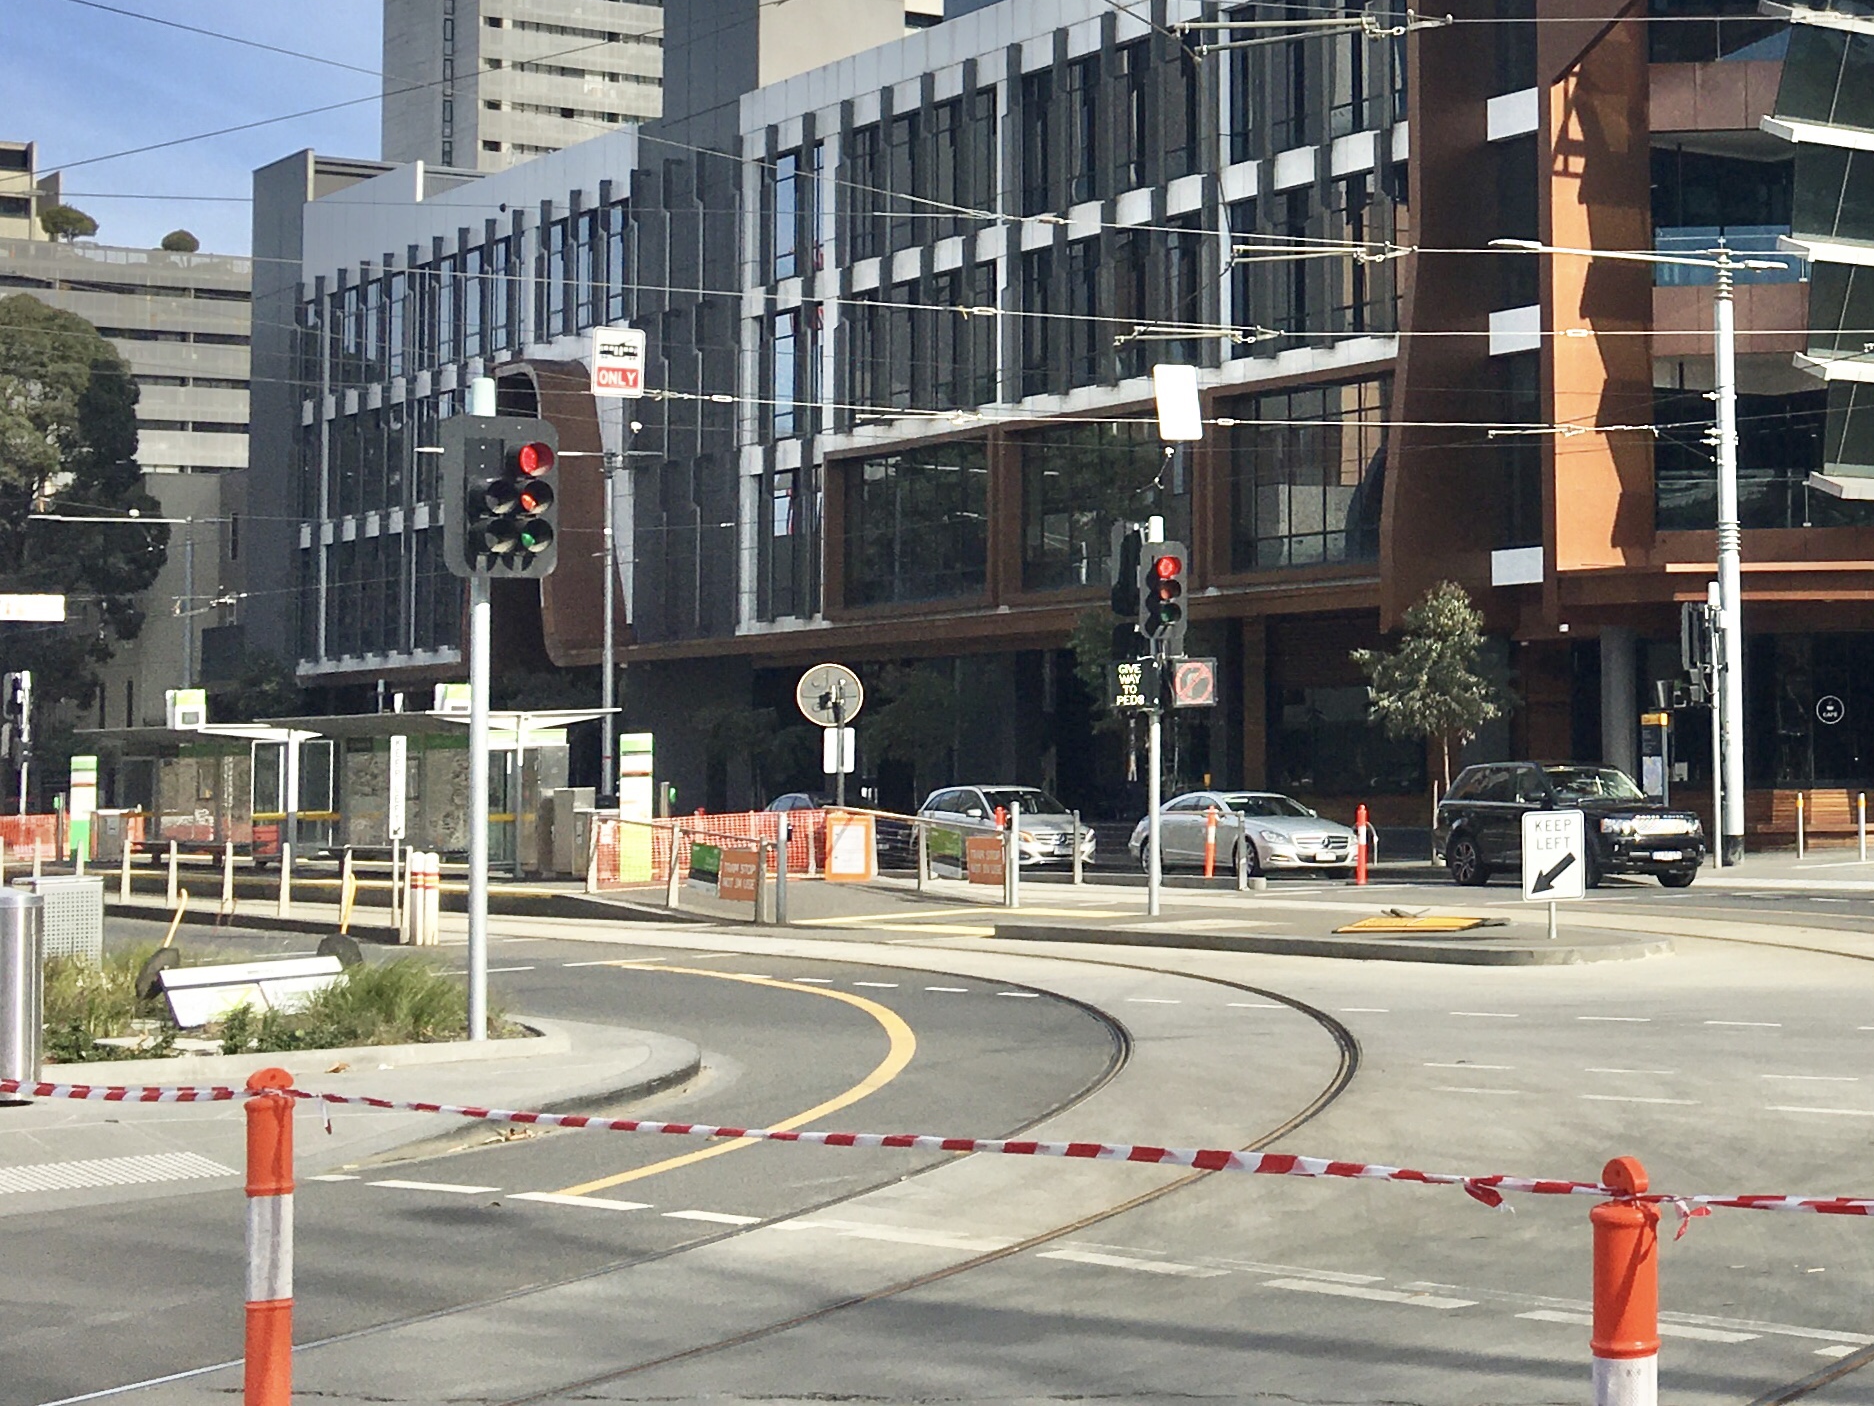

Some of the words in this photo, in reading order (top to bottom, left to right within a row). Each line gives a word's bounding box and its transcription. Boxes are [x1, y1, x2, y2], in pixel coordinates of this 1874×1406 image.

[599, 370, 637, 386] ONLY
[1118, 663, 1142, 674] GIVE
[1119, 674, 1141, 684] WAY
[1122, 684, 1138, 695] TO
[1535, 818, 1572, 832] KEEP
[1536, 836, 1571, 851] LEFT
